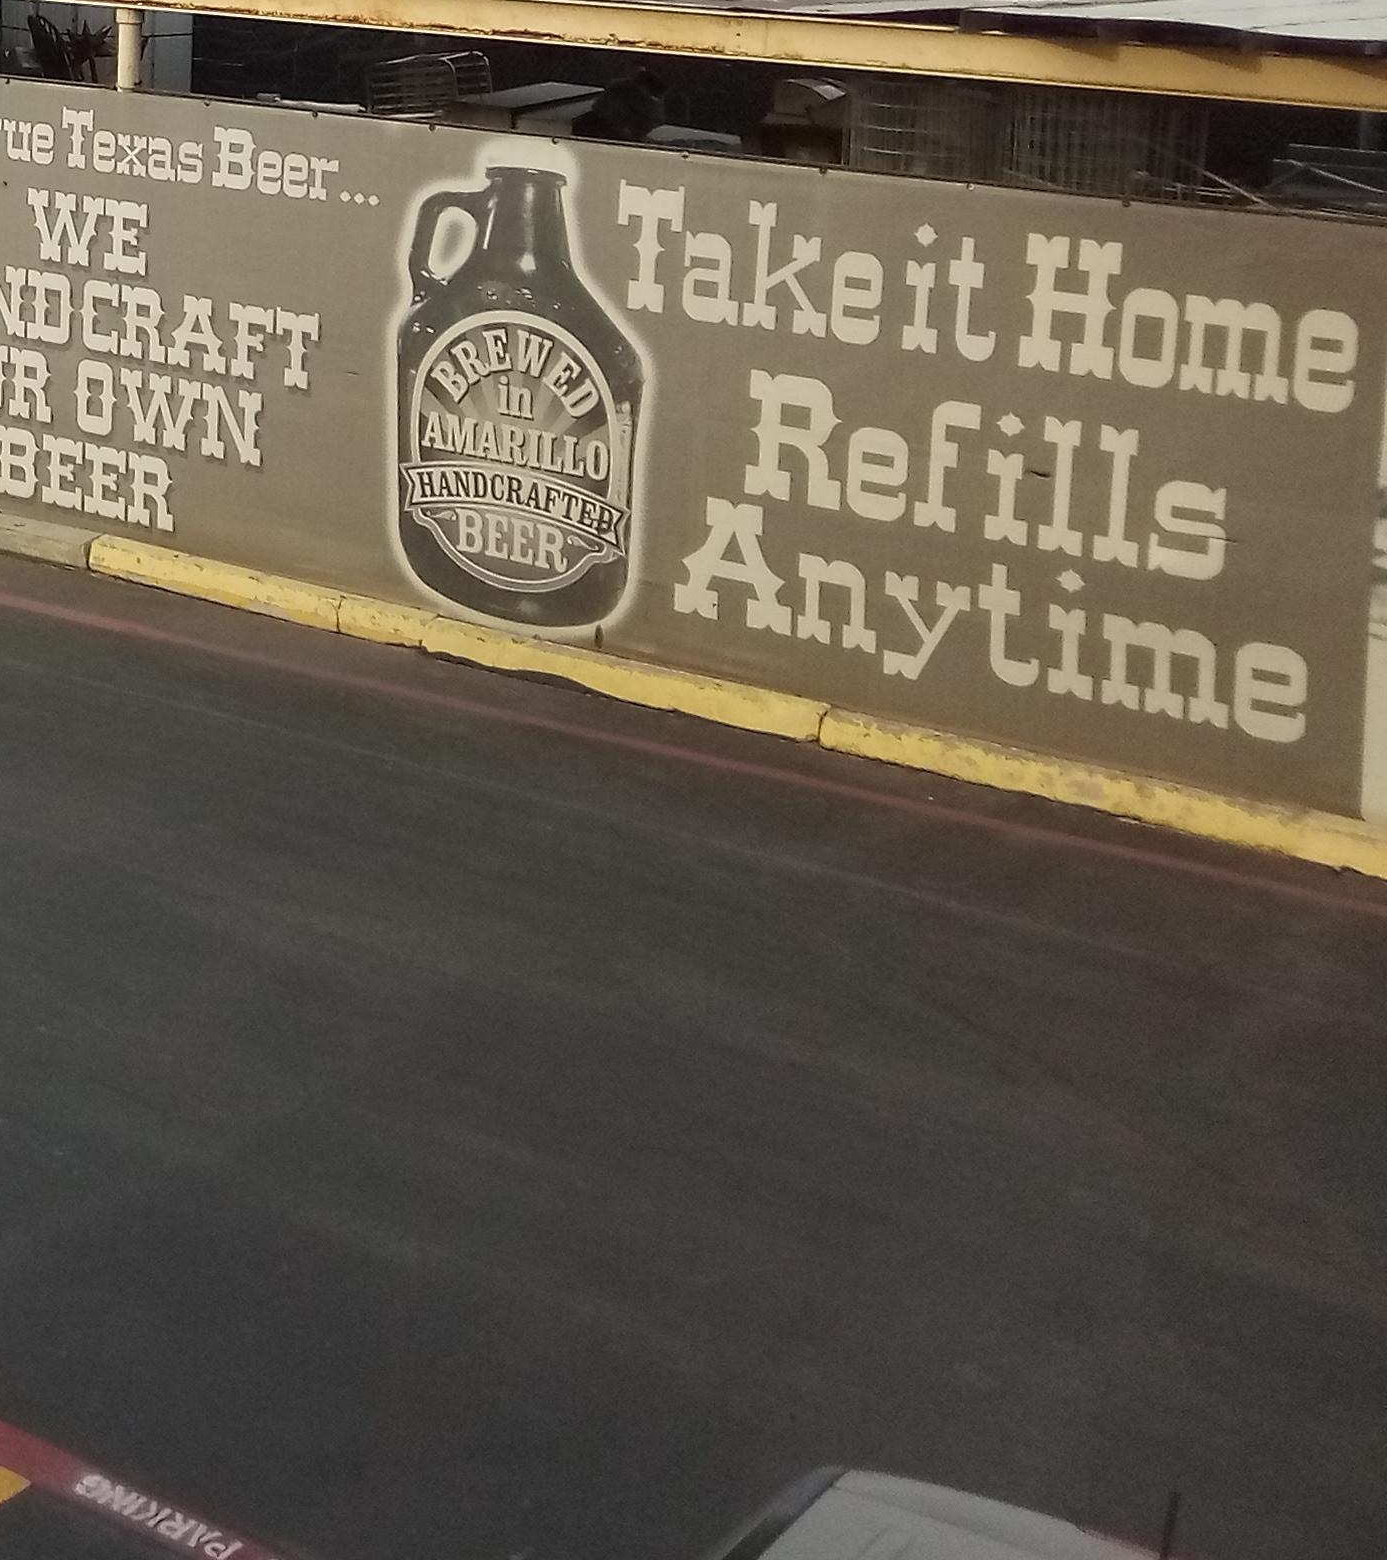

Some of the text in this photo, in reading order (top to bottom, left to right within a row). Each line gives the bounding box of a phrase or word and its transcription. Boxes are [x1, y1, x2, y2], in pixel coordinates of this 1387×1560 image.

[61, 106, 205, 184] Texas
[27, 187, 149, 276] WE
[618, 178, 1360, 415] Take it Home
[74, 359, 264, 467] OWN
[430, 328, 600, 419] BREWED
[498, 376, 534, 421] in
[421, 411, 611, 481] AMARILLO
[743, 368, 1229, 582] Refills
[416, 470, 615, 534] HANDCRAFTED
[455, 507, 569, 574] BEER
[672, 495, 1310, 744] Anytime
[74, 1473, 244, 1560] PARKING
